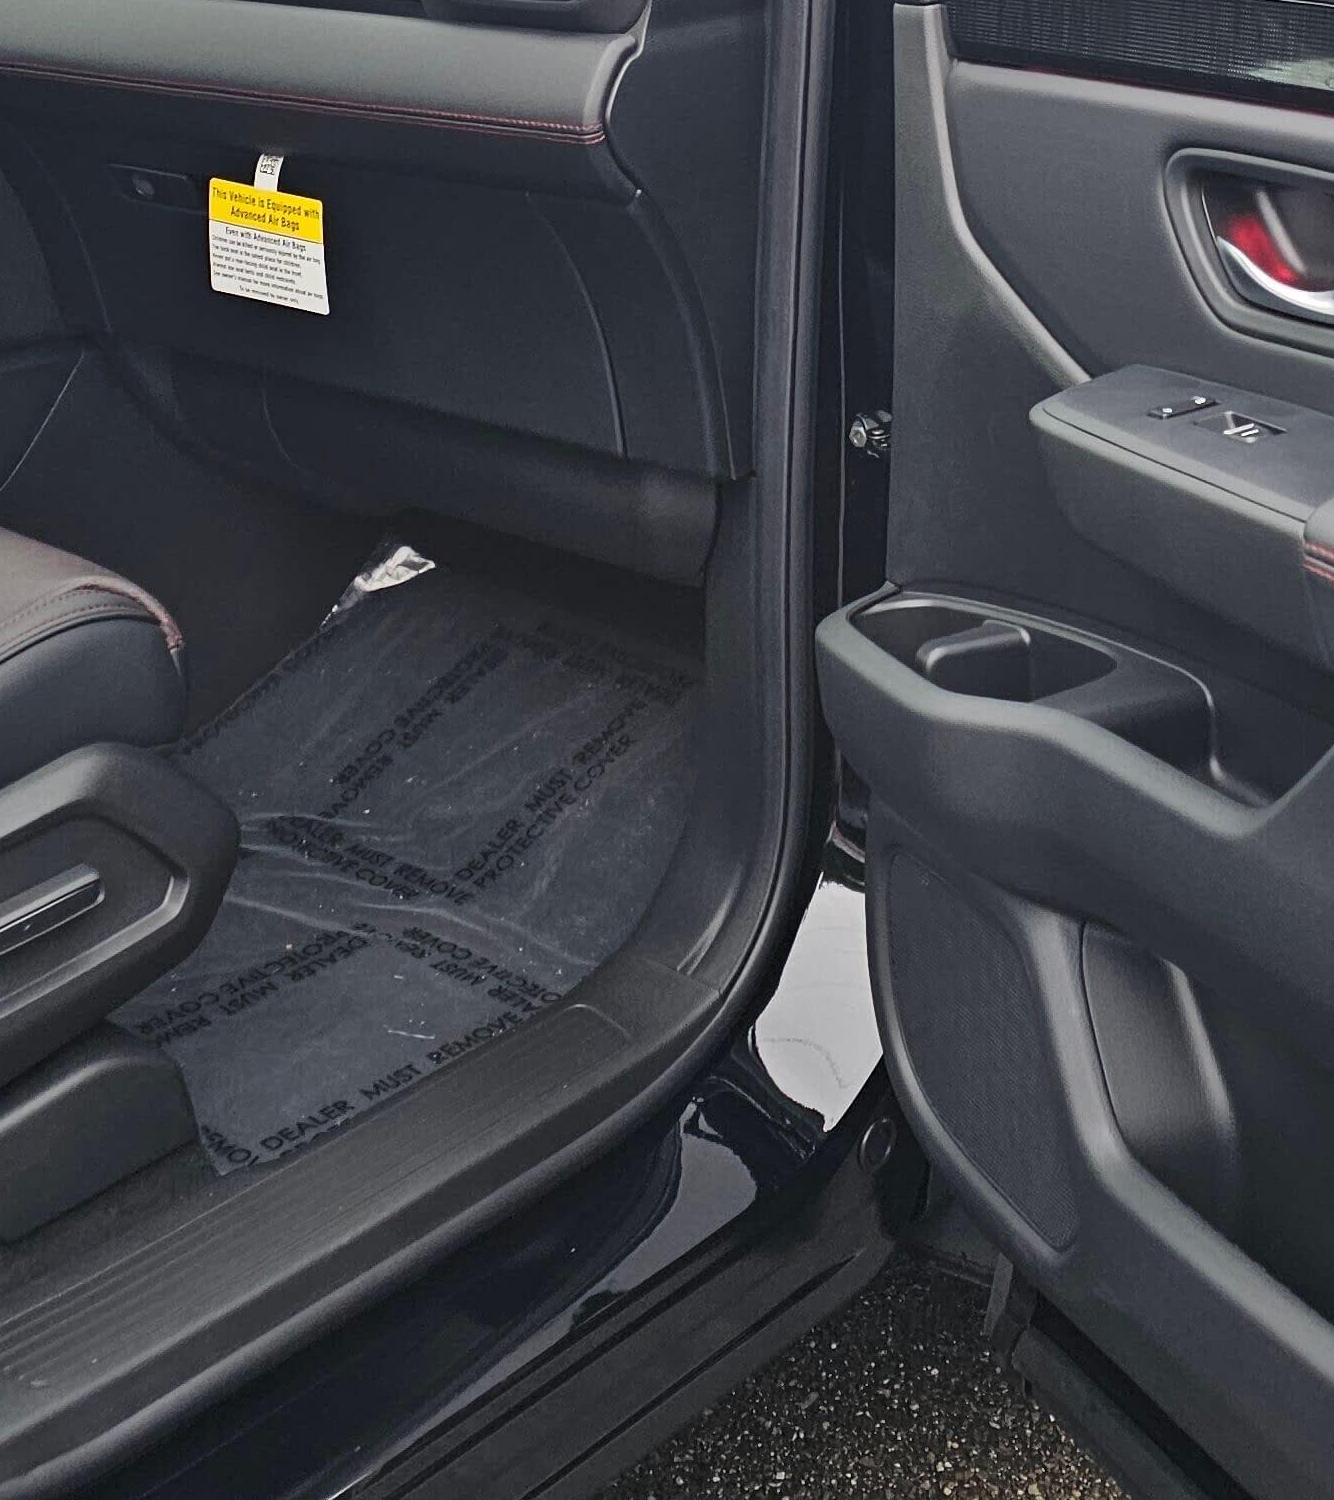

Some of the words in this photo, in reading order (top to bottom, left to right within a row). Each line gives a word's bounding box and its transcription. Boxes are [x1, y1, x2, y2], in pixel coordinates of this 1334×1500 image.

[212, 188, 227, 201] This
[229, 192, 256, 207] Vehicle
[258, 197, 264, 208] is
[267, 199, 302, 216] Equipped
[304, 207, 319, 219] with
[230, 206, 266, 224] Advanced
[269, 214, 280, 225] Air
[282, 216, 299, 232] Bags
[253, 233, 281, 246] Advanced
[454, 818, 525, 881] DEALER
[524, 766, 573, 813] MUST
[473, 790, 577, 889] PROTECTIVE
[574, 734, 635, 792] COVER
[344, 843, 396, 867] MUST
[393, 863, 474, 905] REMOVE
[284, 935, 370, 981] DEALER
[429, 959, 488, 986] MUST
[135, 991, 220, 1035] COVER
[219, 981, 279, 1016] MUST
[259, 1098, 356, 1151] DEALER
[358, 1062, 424, 1102] MUST
[426, 1010, 525, 1065] REMOVE
